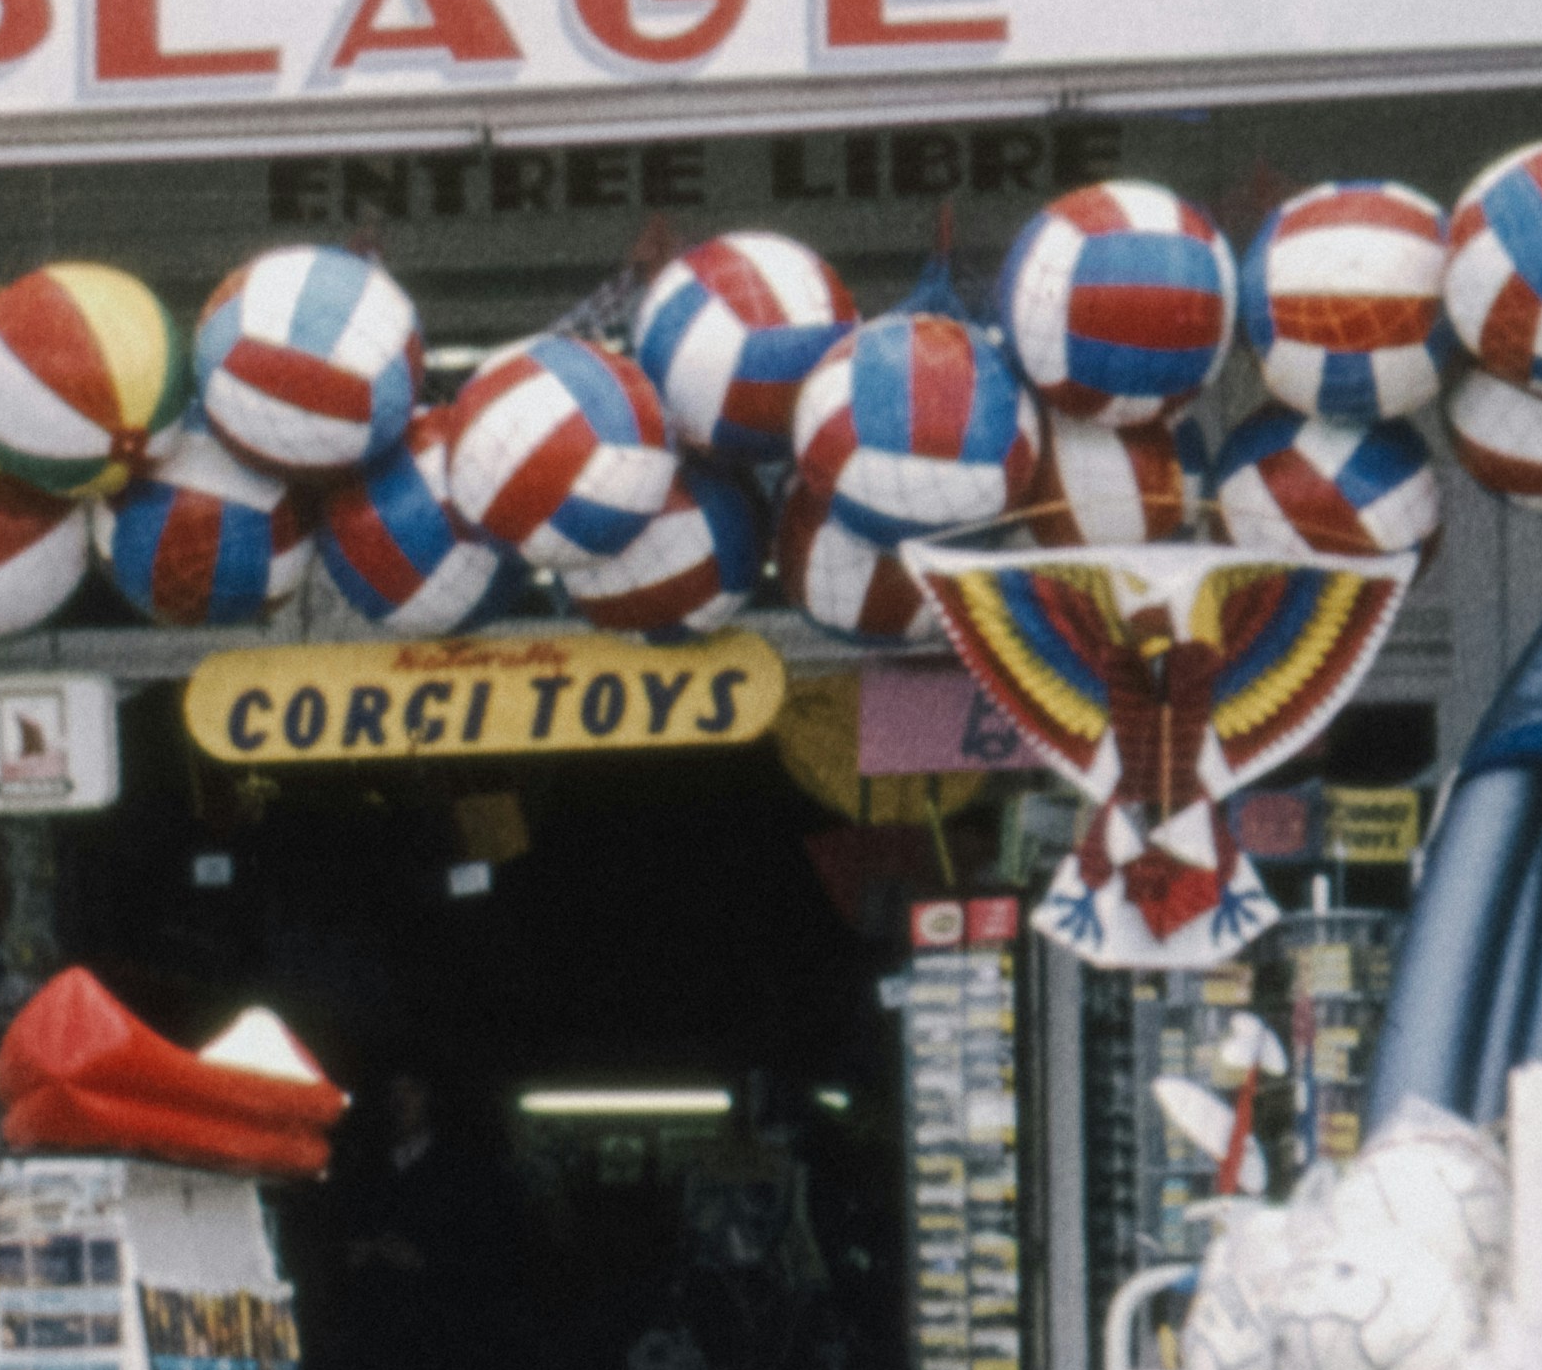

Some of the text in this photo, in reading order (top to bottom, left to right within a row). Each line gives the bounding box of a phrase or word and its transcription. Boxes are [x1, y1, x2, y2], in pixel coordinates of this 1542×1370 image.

[267, 120, 1124, 225] ENTREE LIBRE
[226, 666, 749, 752] CORGI TOYS
